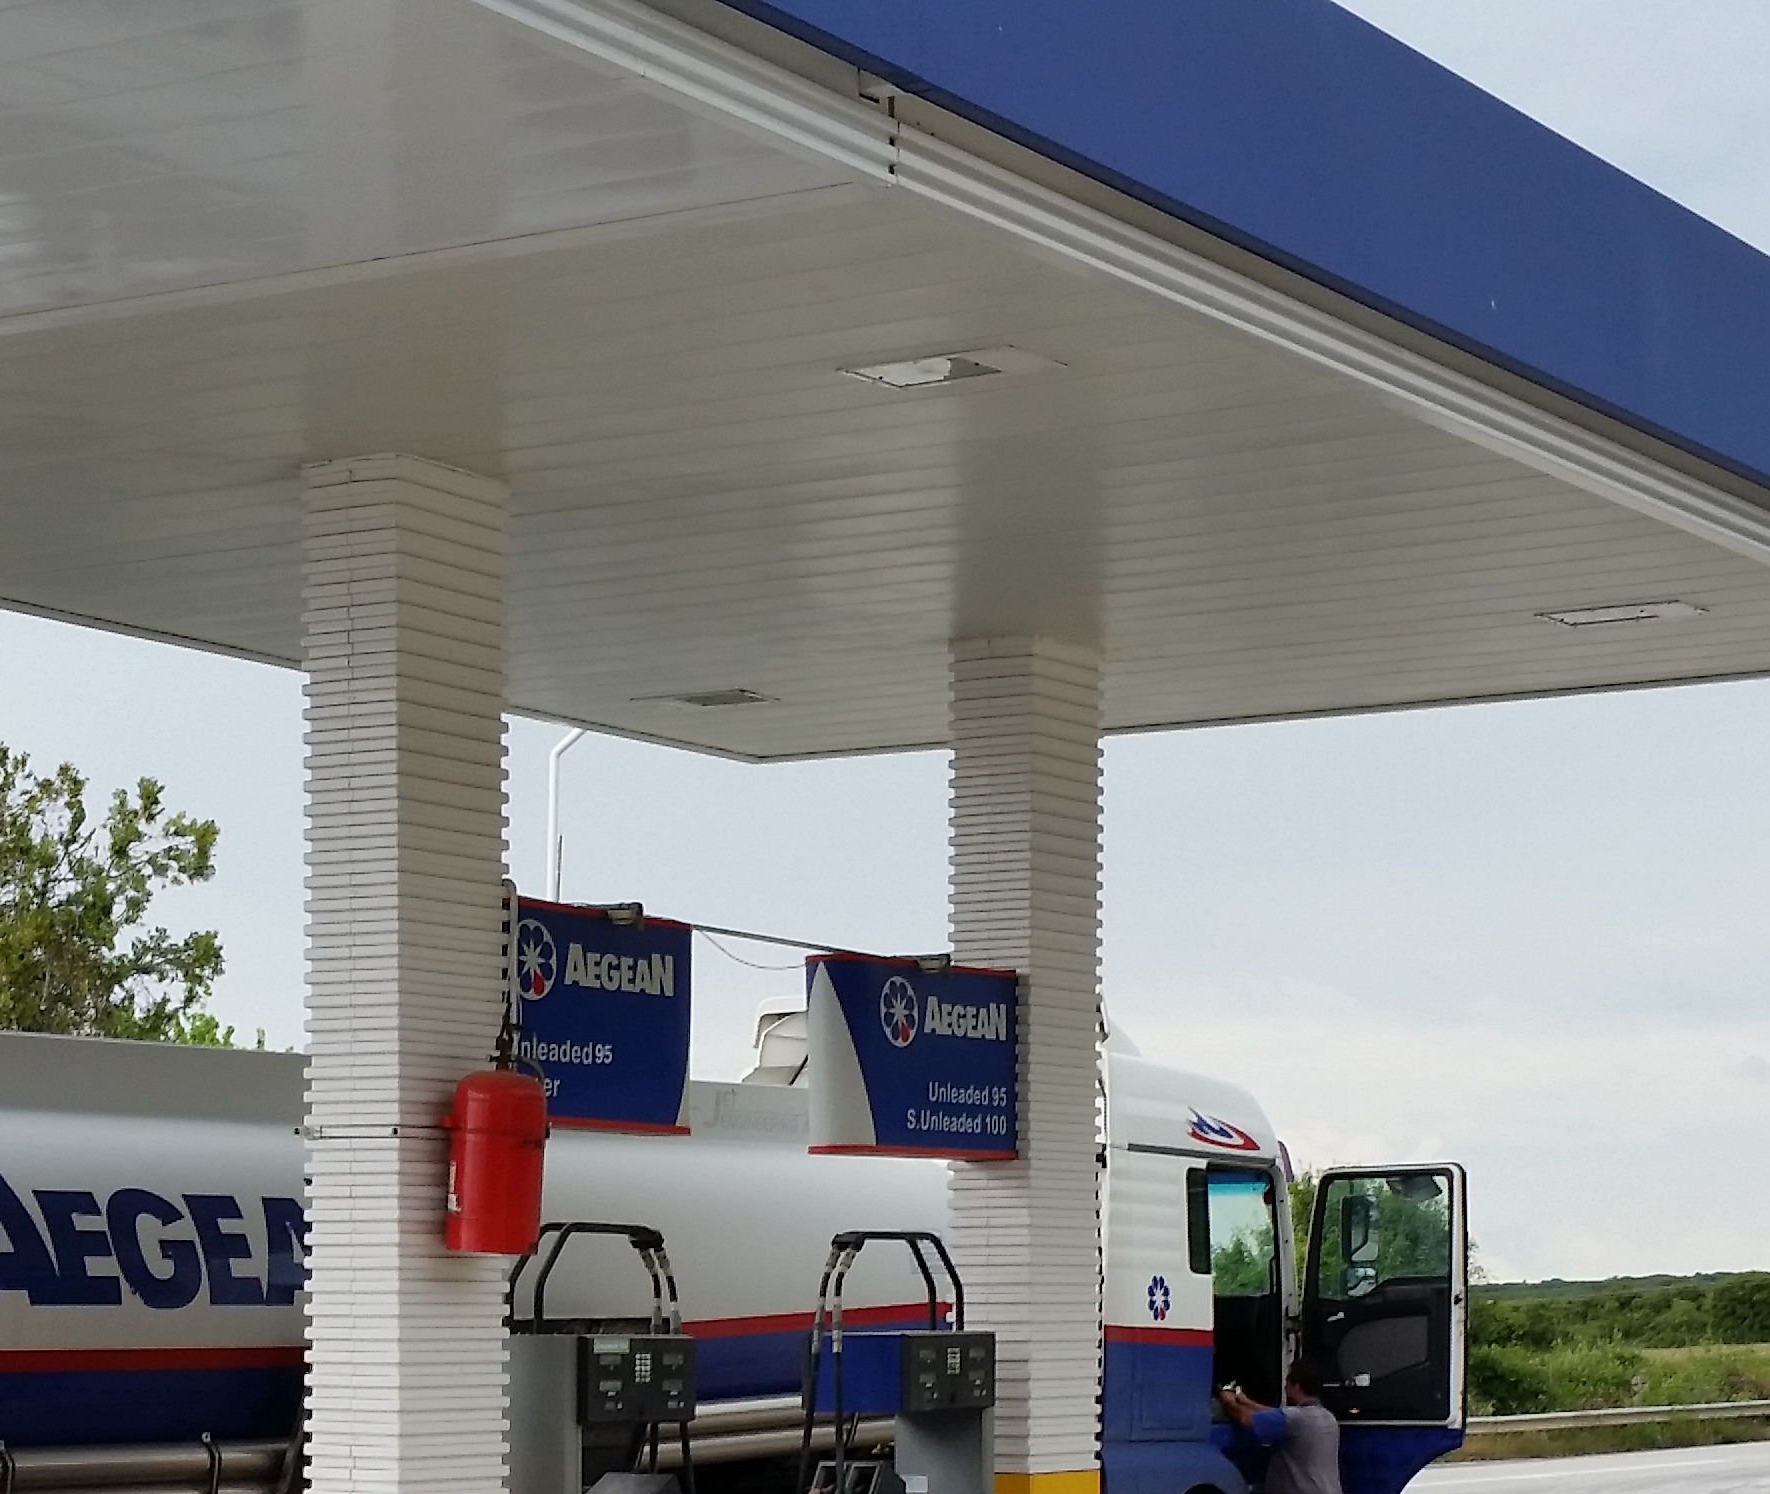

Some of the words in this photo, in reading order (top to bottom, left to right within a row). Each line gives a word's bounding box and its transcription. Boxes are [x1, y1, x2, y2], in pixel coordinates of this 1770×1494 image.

[563, 942, 675, 997] AEGEAN
[923, 995, 1007, 1041] AEGEAN
[594, 1043, 613, 1065] 95
[928, 1081, 989, 1106] Unleaded
[991, 1086, 1008, 1107] 95
[906, 1107, 982, 1134] S.Unleaded
[985, 1114, 1008, 1136] 100
